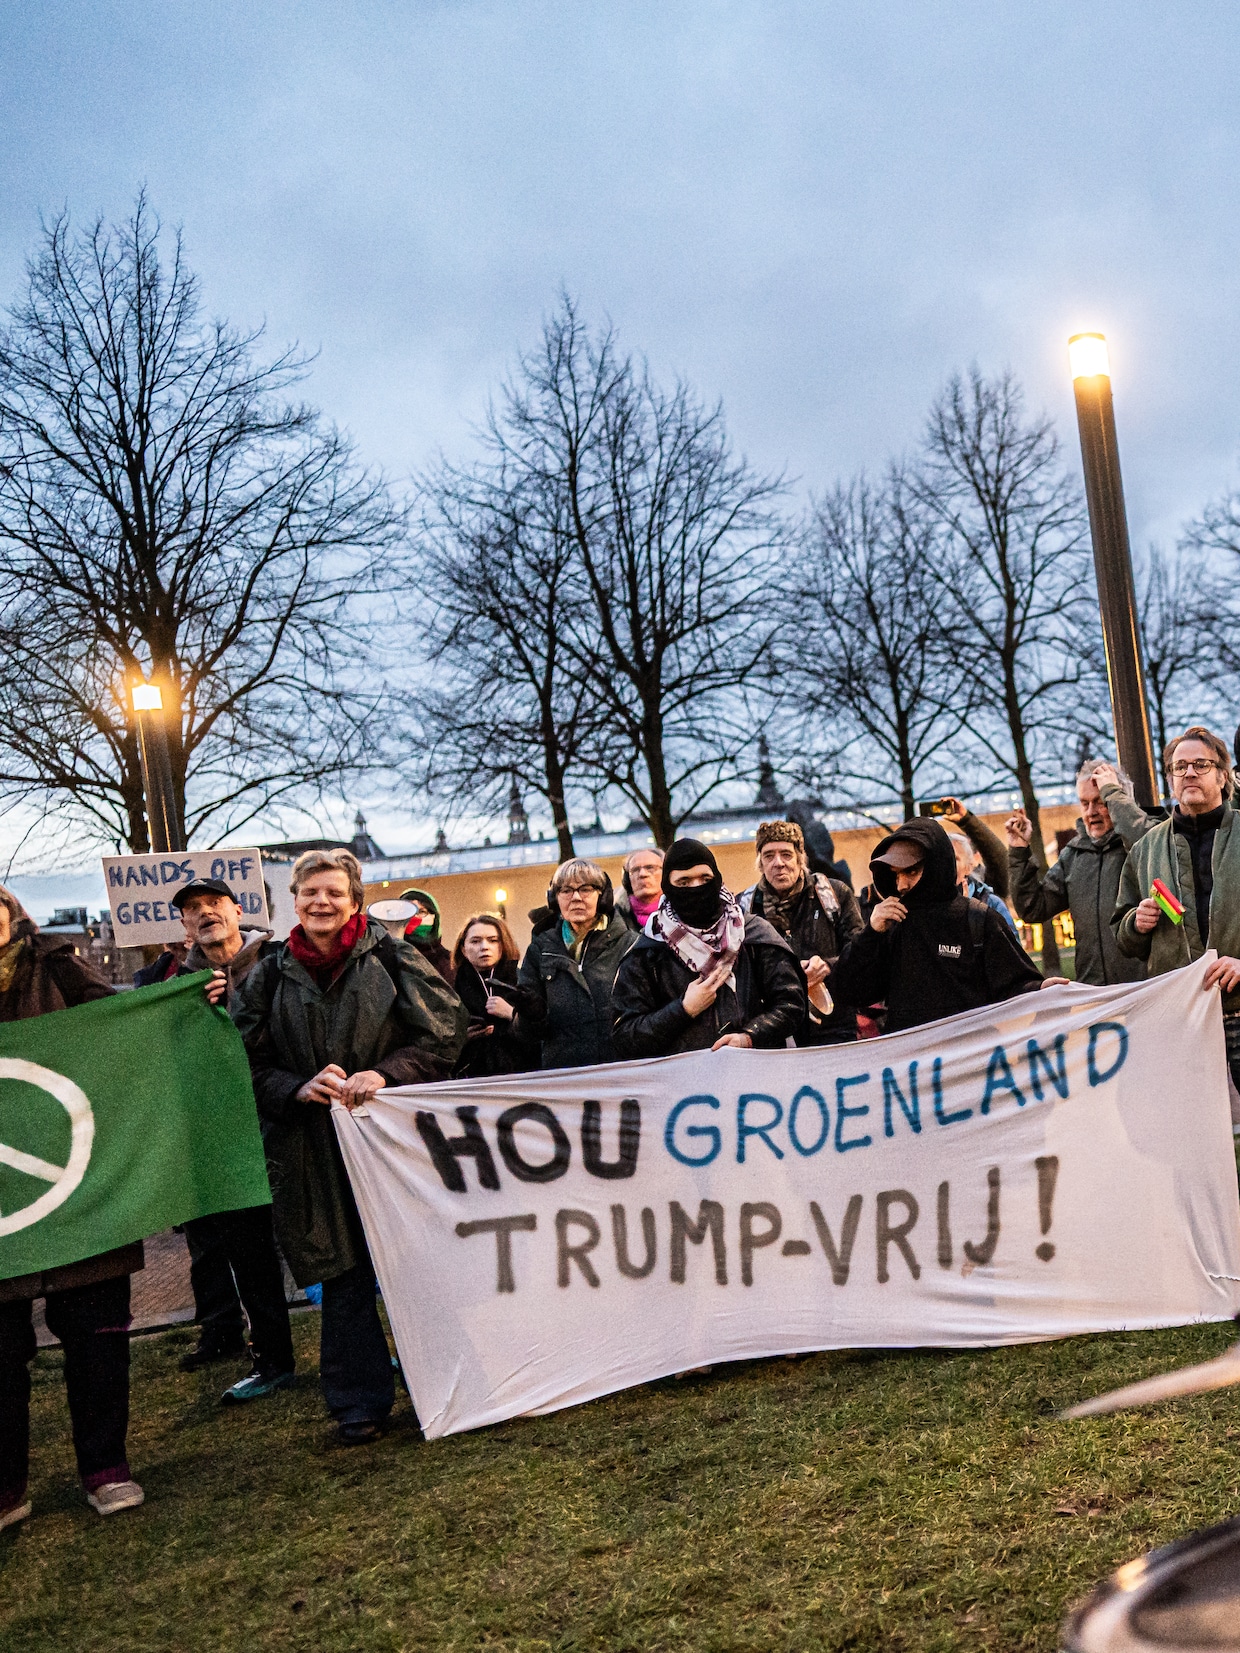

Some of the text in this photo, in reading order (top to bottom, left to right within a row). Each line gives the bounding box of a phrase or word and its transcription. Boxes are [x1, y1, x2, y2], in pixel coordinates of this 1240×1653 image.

[108, 857, 255, 888] HANDS OFF
[116, 892, 263, 925] GREEND
[415, 1021, 1130, 1193] HOU GROENLAND
